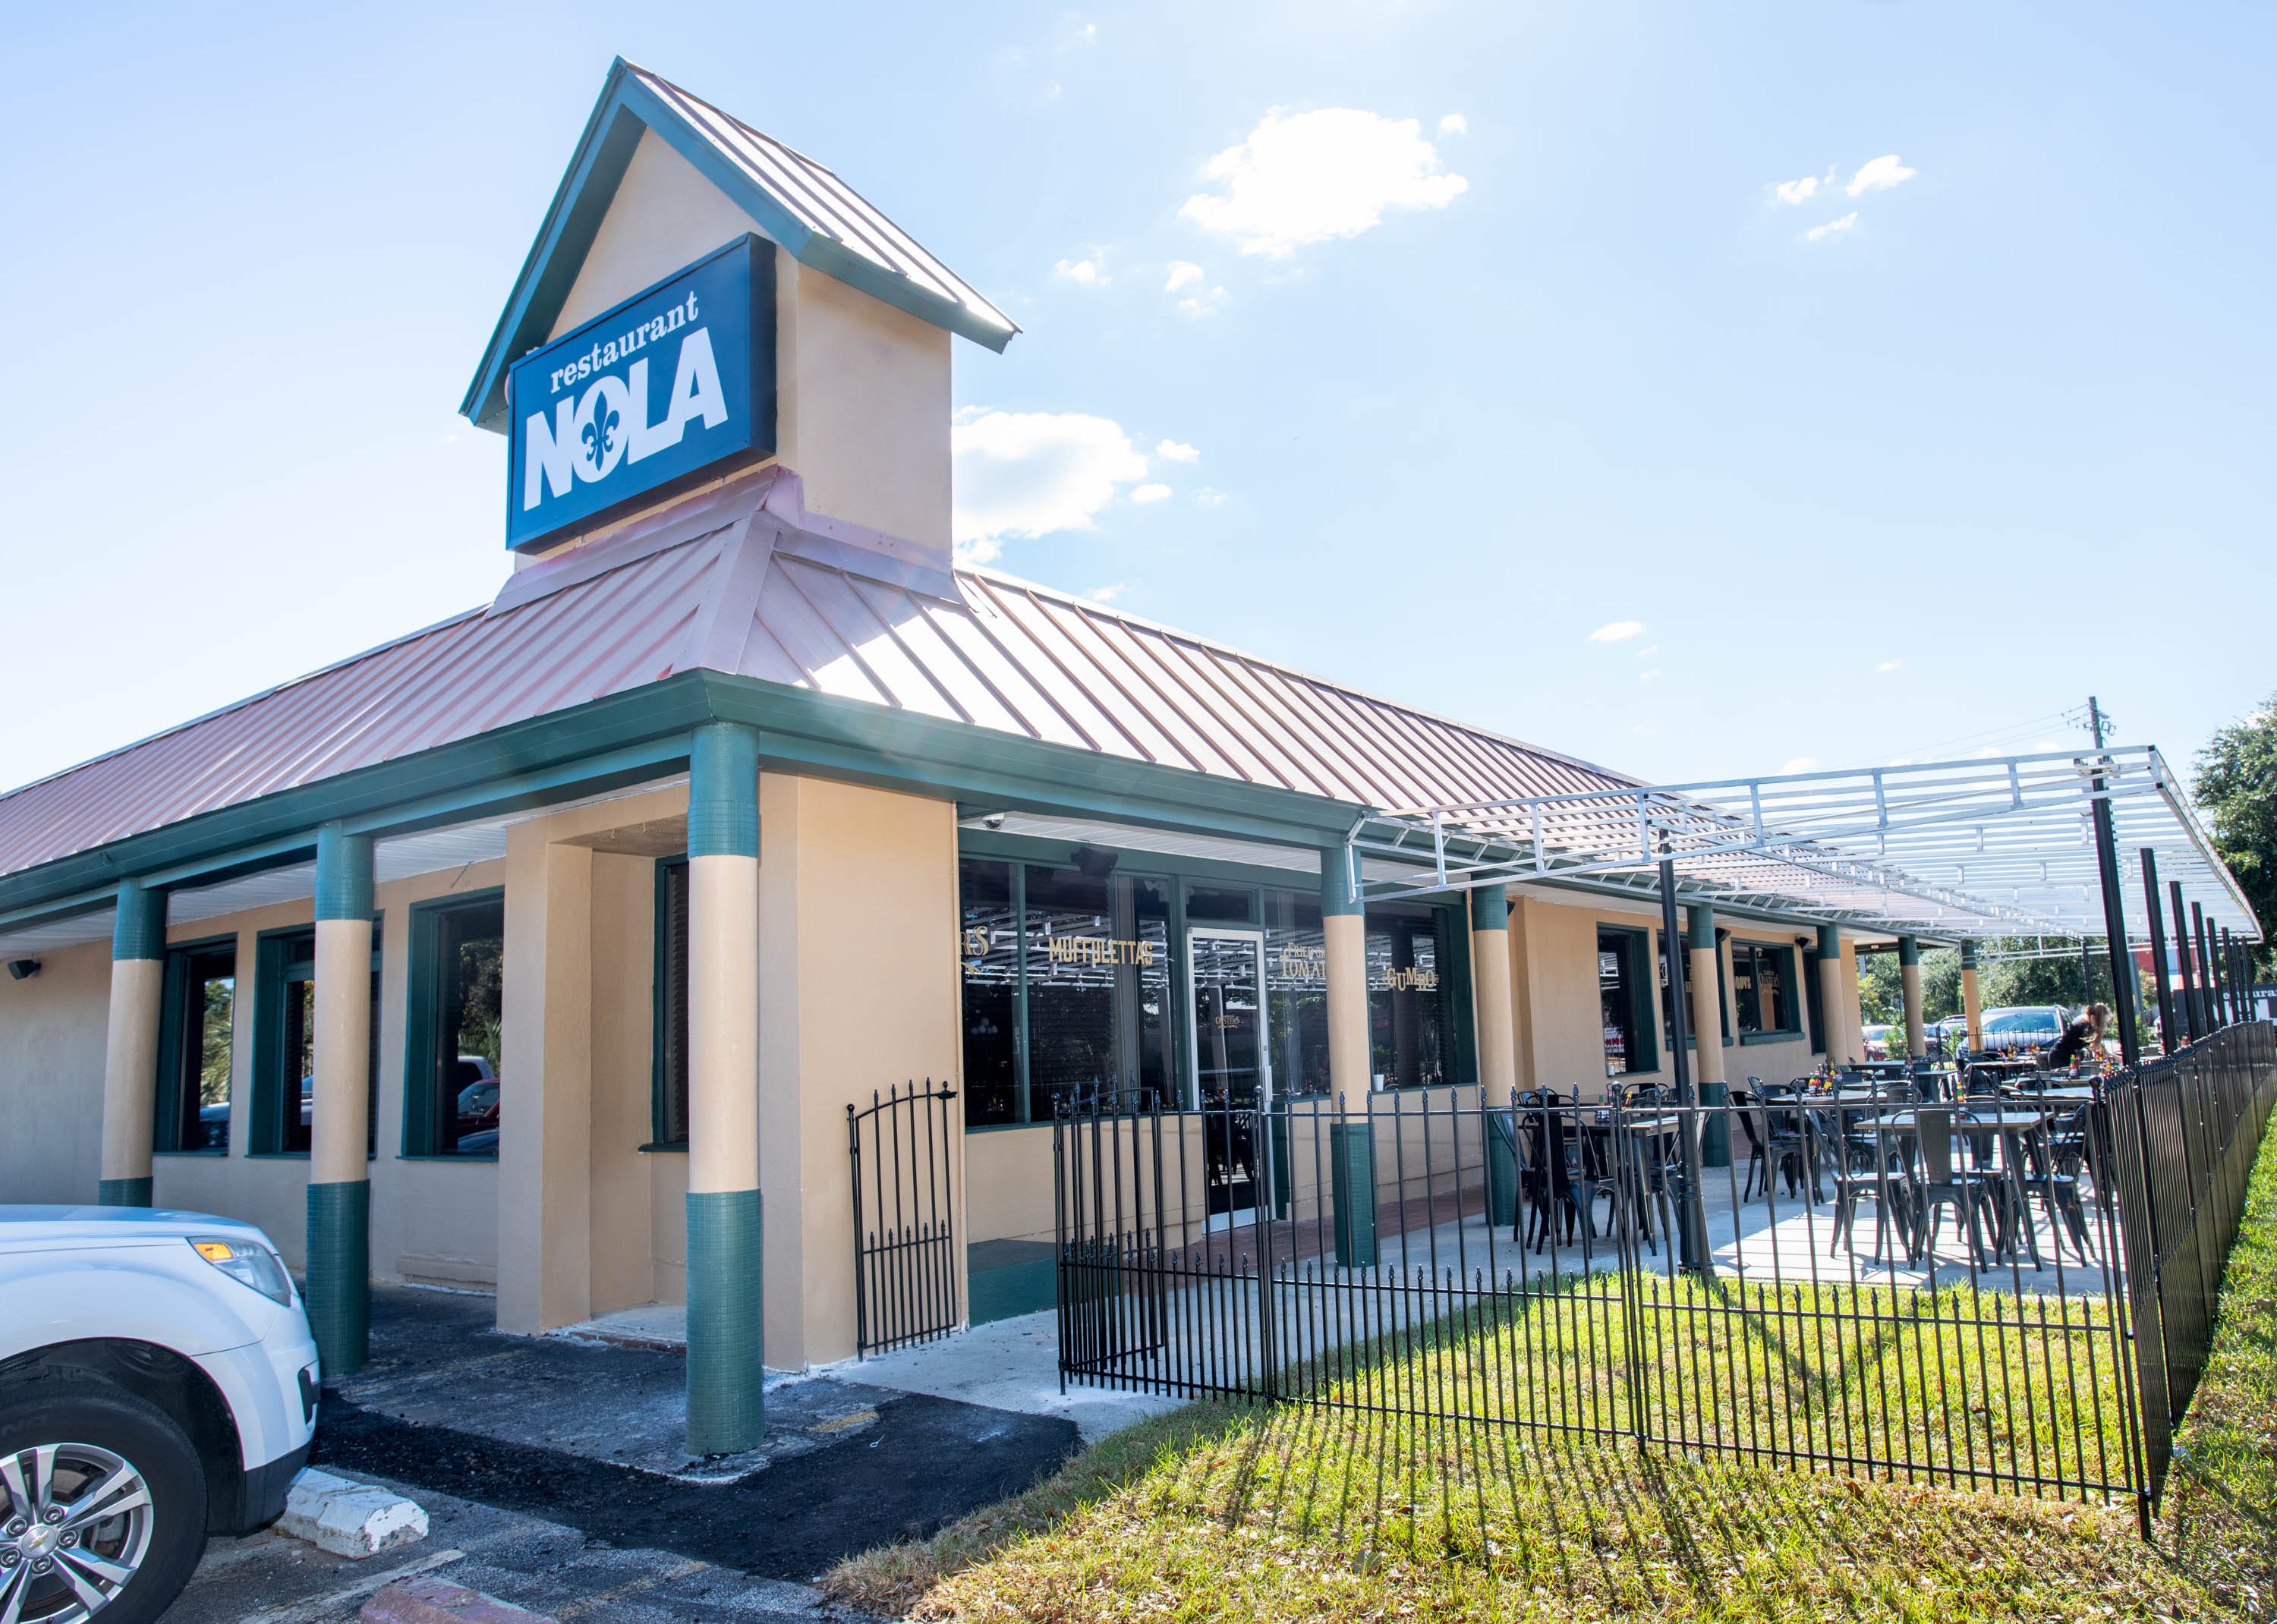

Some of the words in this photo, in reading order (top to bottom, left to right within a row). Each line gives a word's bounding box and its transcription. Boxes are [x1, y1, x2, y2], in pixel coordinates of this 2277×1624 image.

[550, 290, 699, 394] restaurant
[524, 327, 729, 511] NOLA
[1049, 936, 1153, 965] MUFFULETTAS
[1386, 966, 1435, 992] GUMBO
